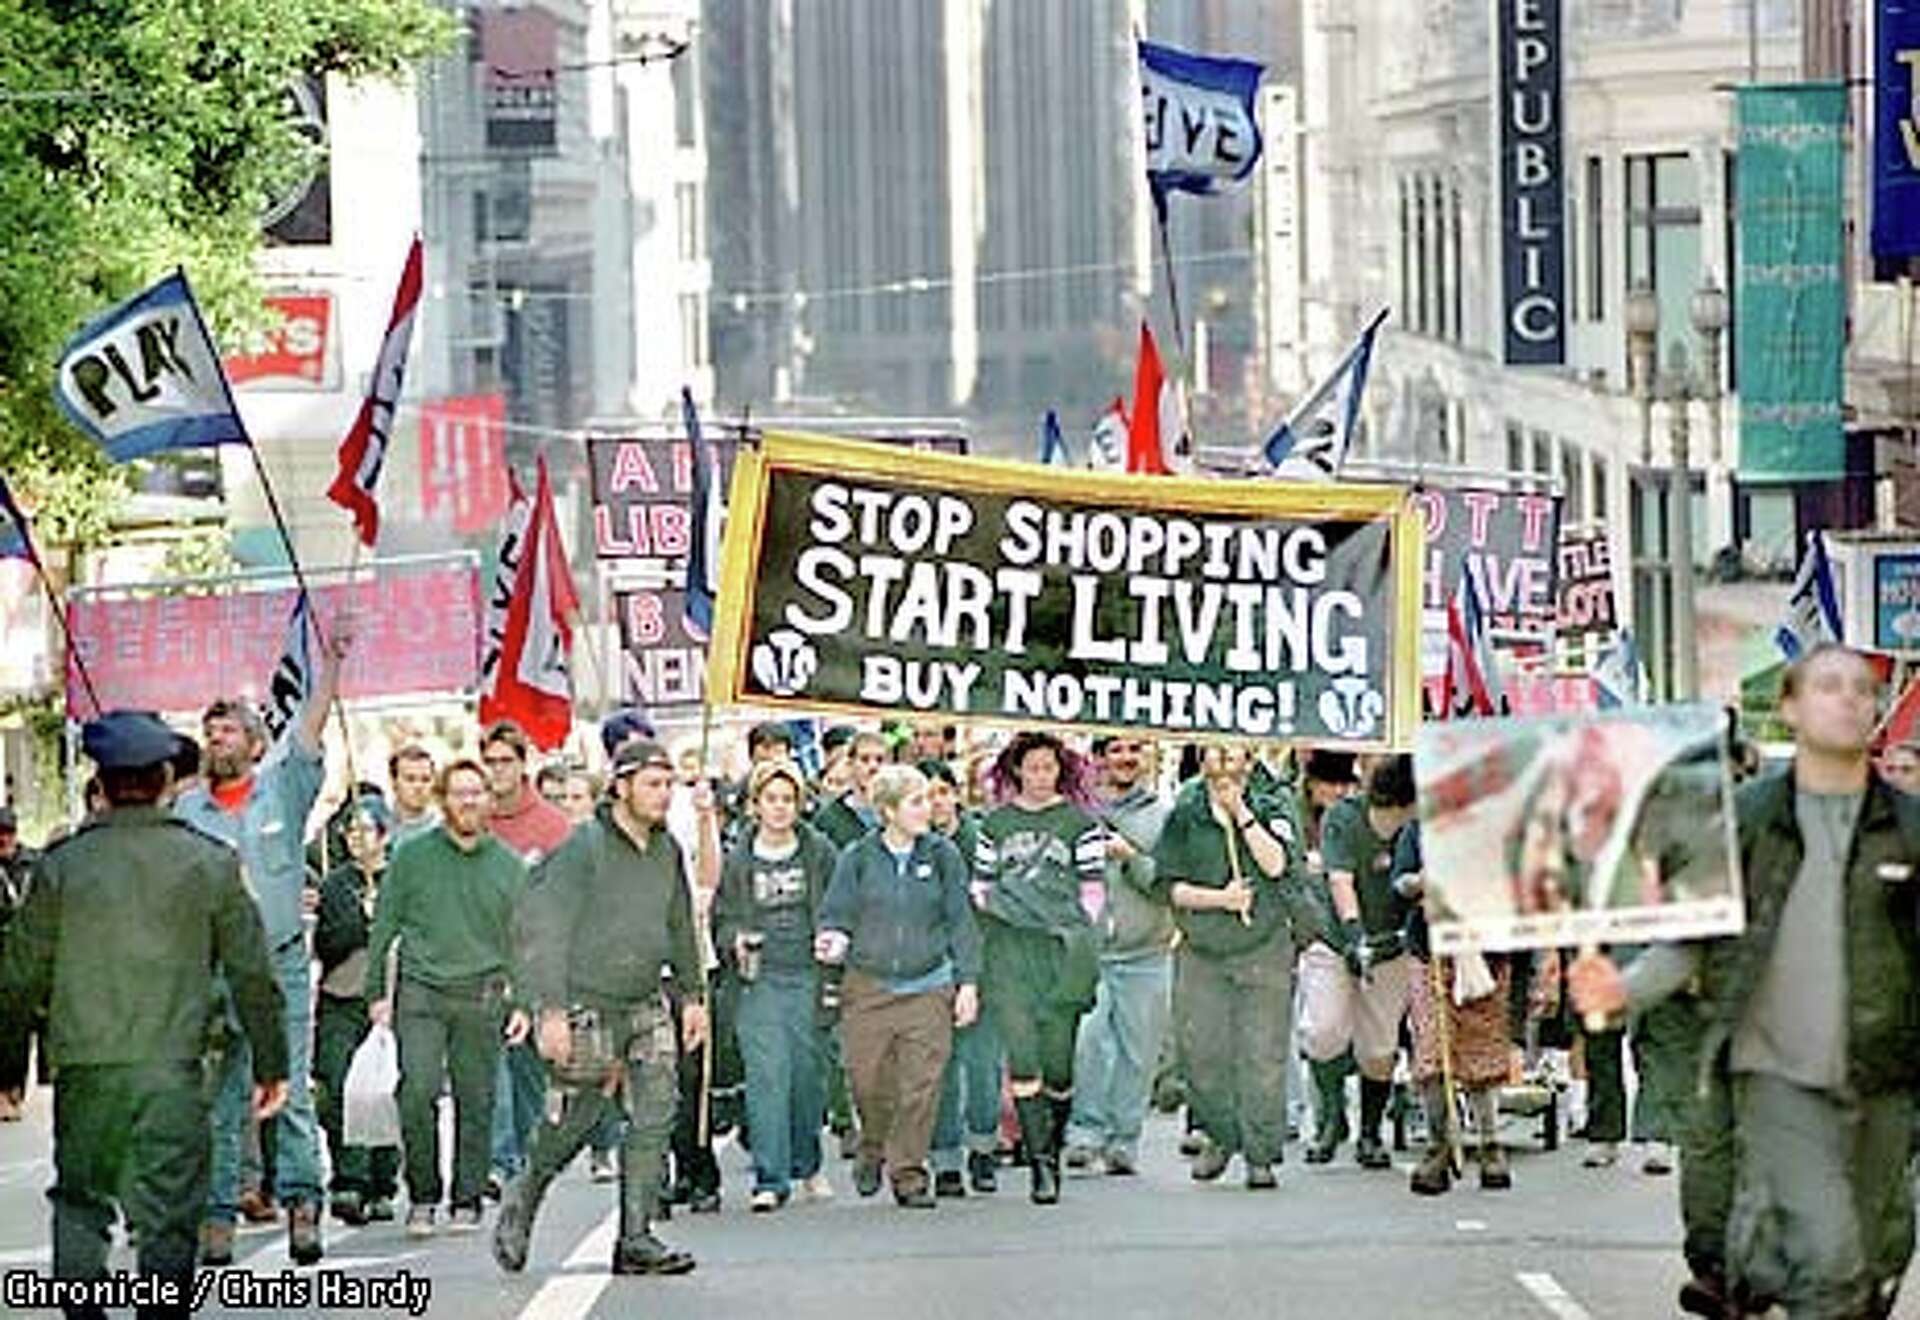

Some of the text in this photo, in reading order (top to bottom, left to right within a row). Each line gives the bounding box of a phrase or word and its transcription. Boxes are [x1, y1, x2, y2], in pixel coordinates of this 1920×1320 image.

[71, 317, 196, 417] PLAY
[810, 482, 1327, 584] STOP SHOPPING
[785, 547, 1365, 675] START LIVING
[860, 656, 1296, 732] BUY NOTHING!
